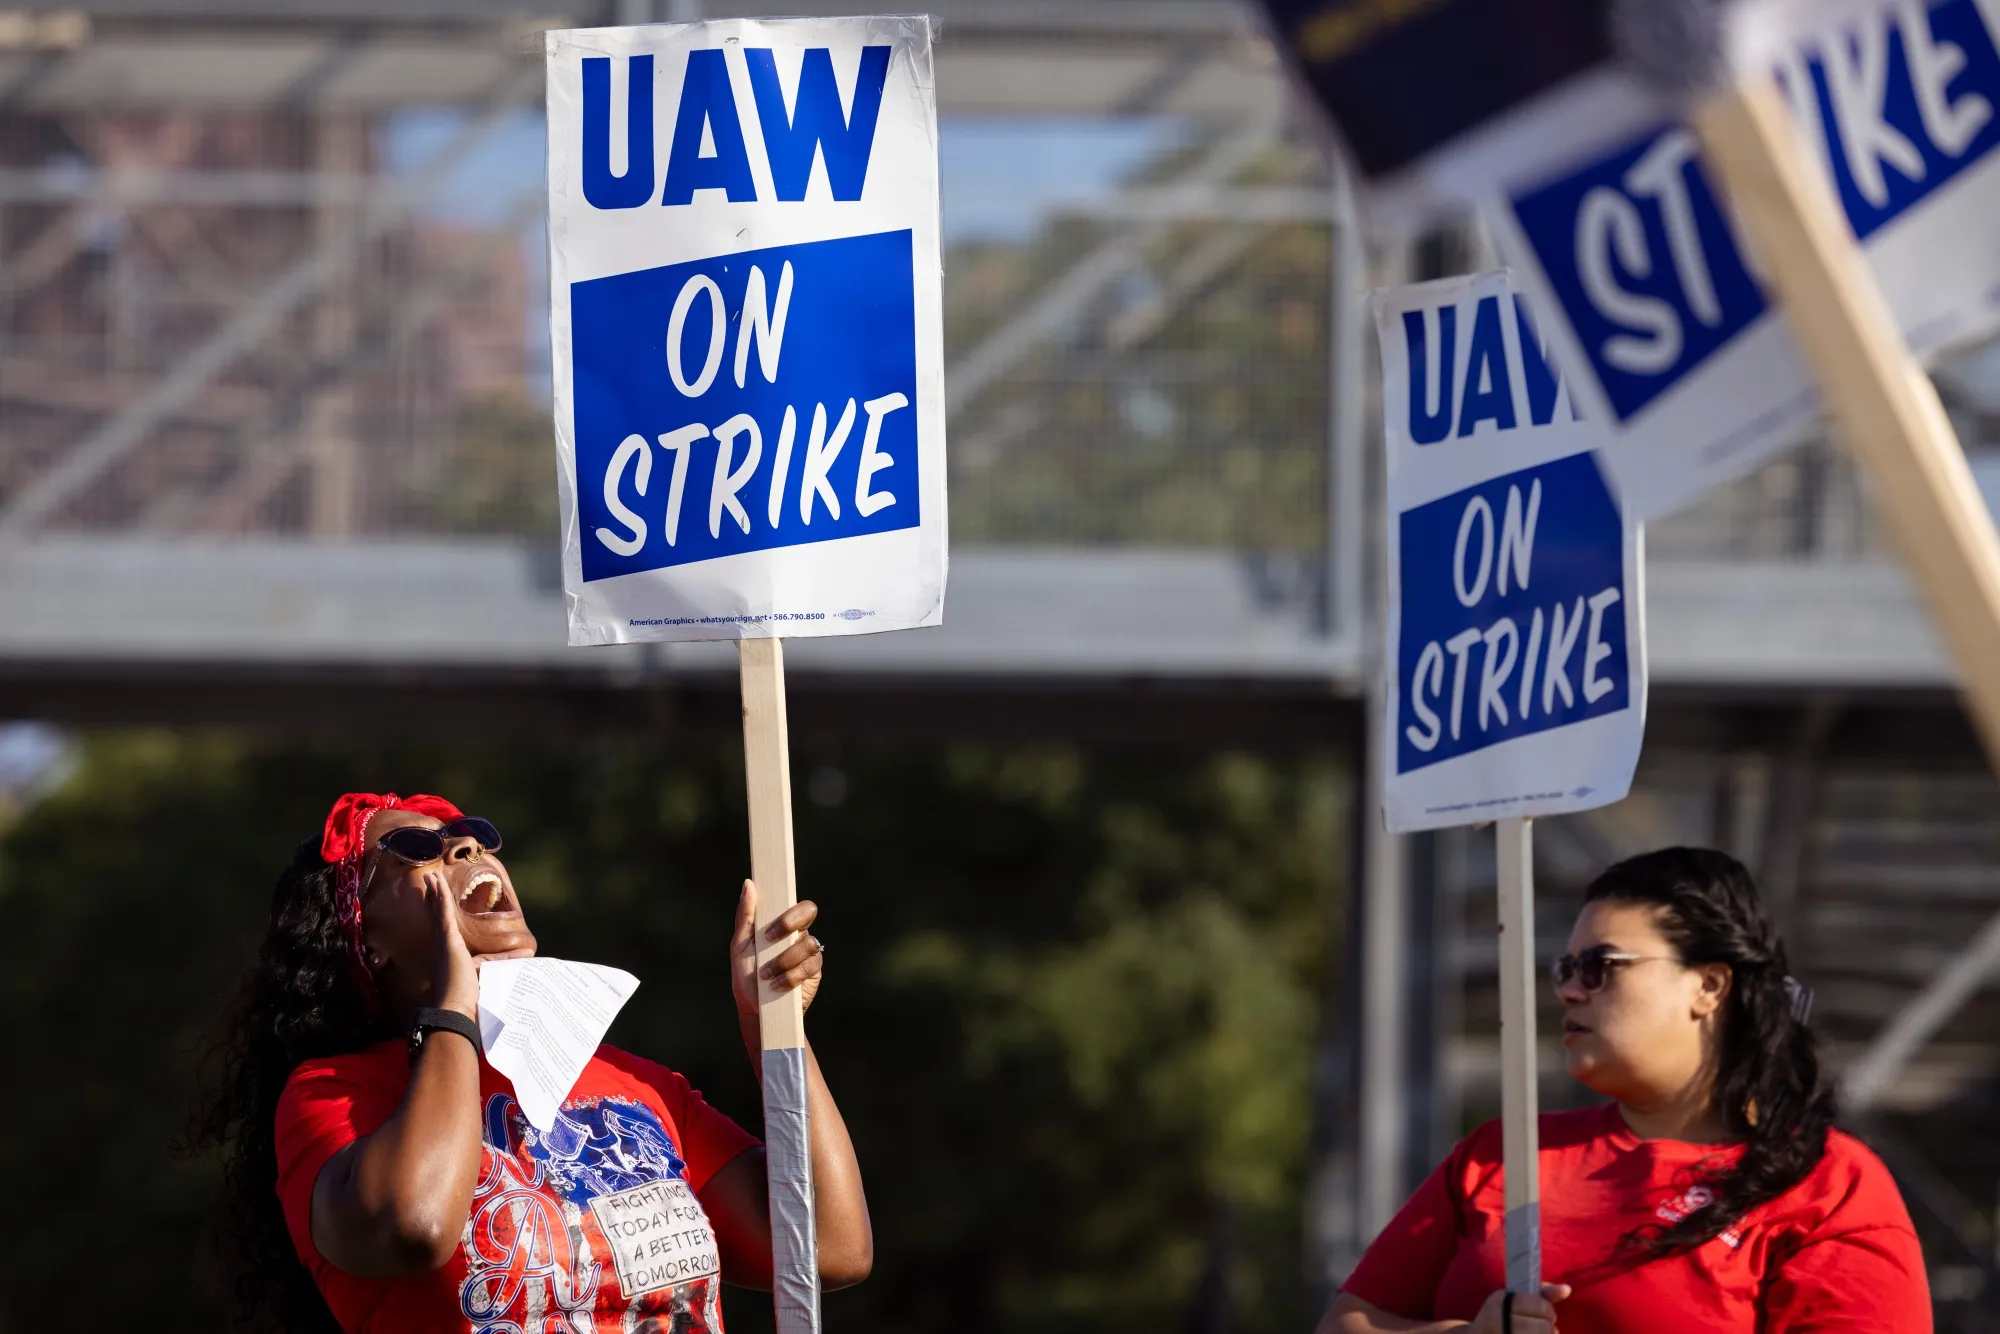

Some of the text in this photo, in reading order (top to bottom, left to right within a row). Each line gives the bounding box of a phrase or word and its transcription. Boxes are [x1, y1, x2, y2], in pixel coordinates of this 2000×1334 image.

[581, 45, 892, 210] UAW
[1573, 0, 1994, 374] STKE
[665, 260, 794, 398] ON
[595, 391, 909, 557] STRIKE
[1453, 476, 1542, 608] ON
[629, 618, 663, 626] American
[664, 617, 695, 626] Graphics
[773, 612, 826, 621] 586.790.8500
[1405, 586, 1621, 752] STRIKE
[609, 1185, 687, 1212] FIGHTING
[609, 1205, 703, 1239] TODAY FOR
[634, 1228, 710, 1262] A BETTER
[623, 1252, 718, 1289] TOMORROW
